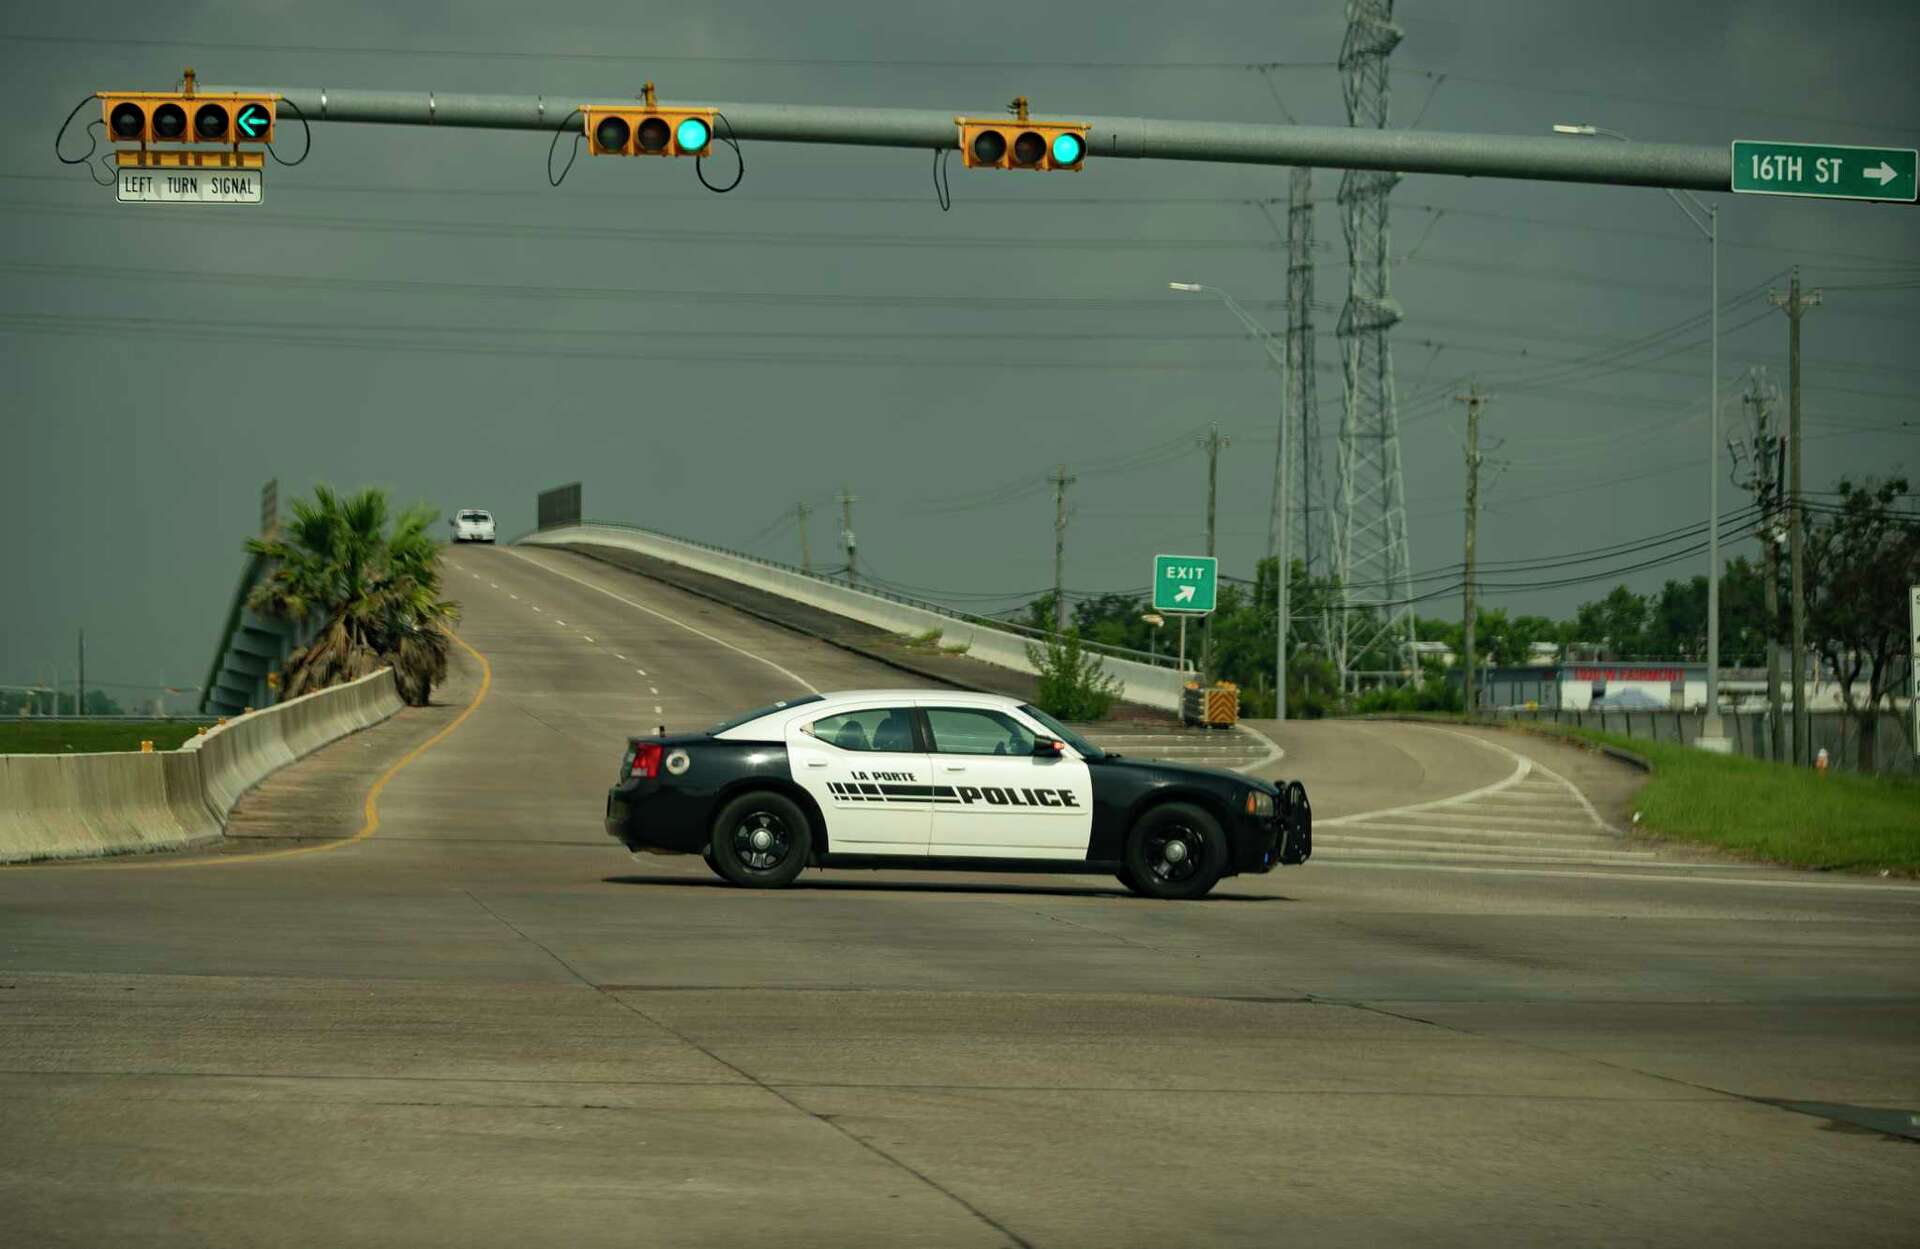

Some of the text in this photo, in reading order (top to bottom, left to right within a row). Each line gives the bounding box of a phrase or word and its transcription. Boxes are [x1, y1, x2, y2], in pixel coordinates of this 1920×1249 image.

[1752, 154, 1843, 184] 16TH ST
[125, 176, 254, 194] LEFT TURN SIGNAL
[1167, 566, 1205, 580] EXIT
[851, 771, 917, 782] LA PORTE
[957, 786, 1081, 807] POLICE
